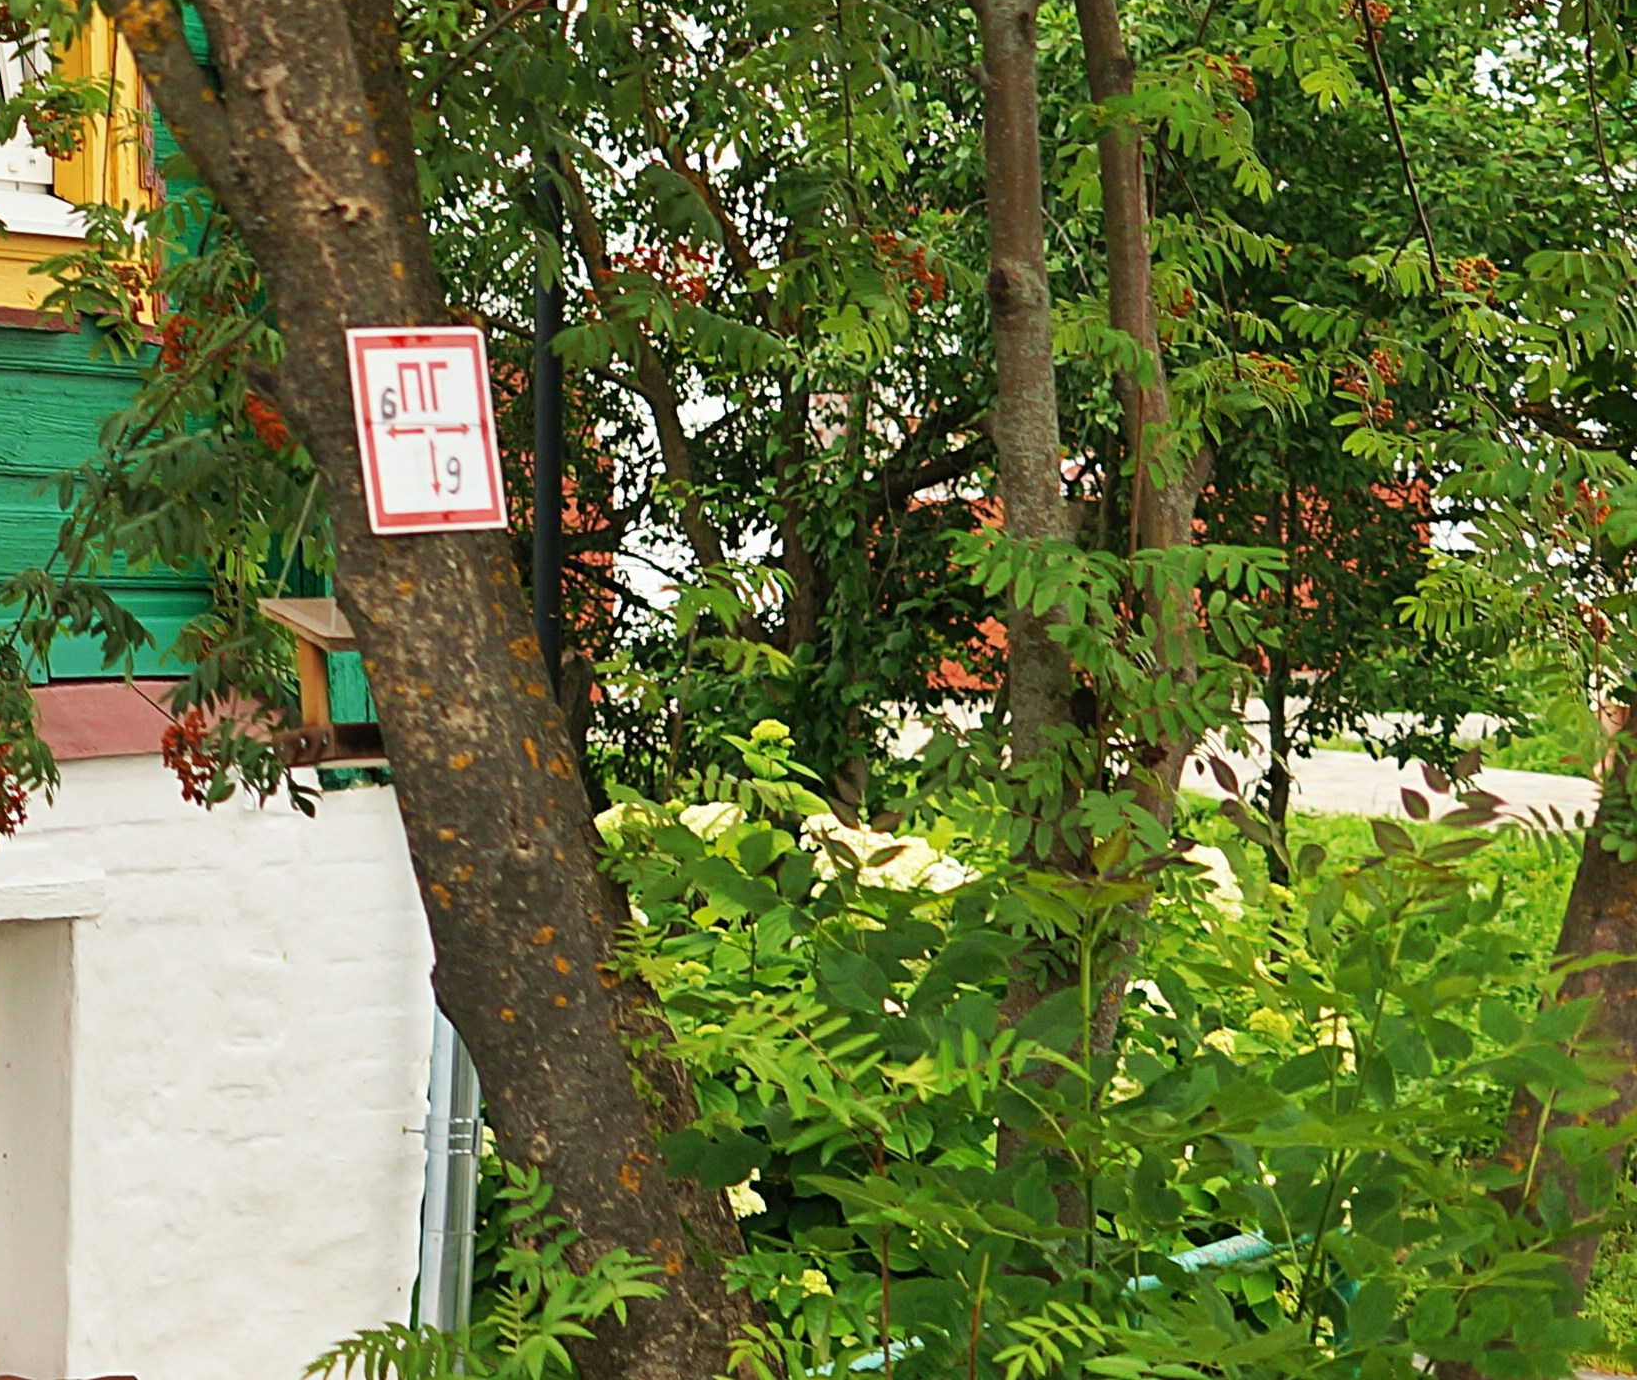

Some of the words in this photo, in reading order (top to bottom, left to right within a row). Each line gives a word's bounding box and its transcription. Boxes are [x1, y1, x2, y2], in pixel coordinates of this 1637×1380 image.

[381, 387, 397, 420] 6
[397, 361, 448, 412] ПГ
[446, 456, 462, 494] 9
